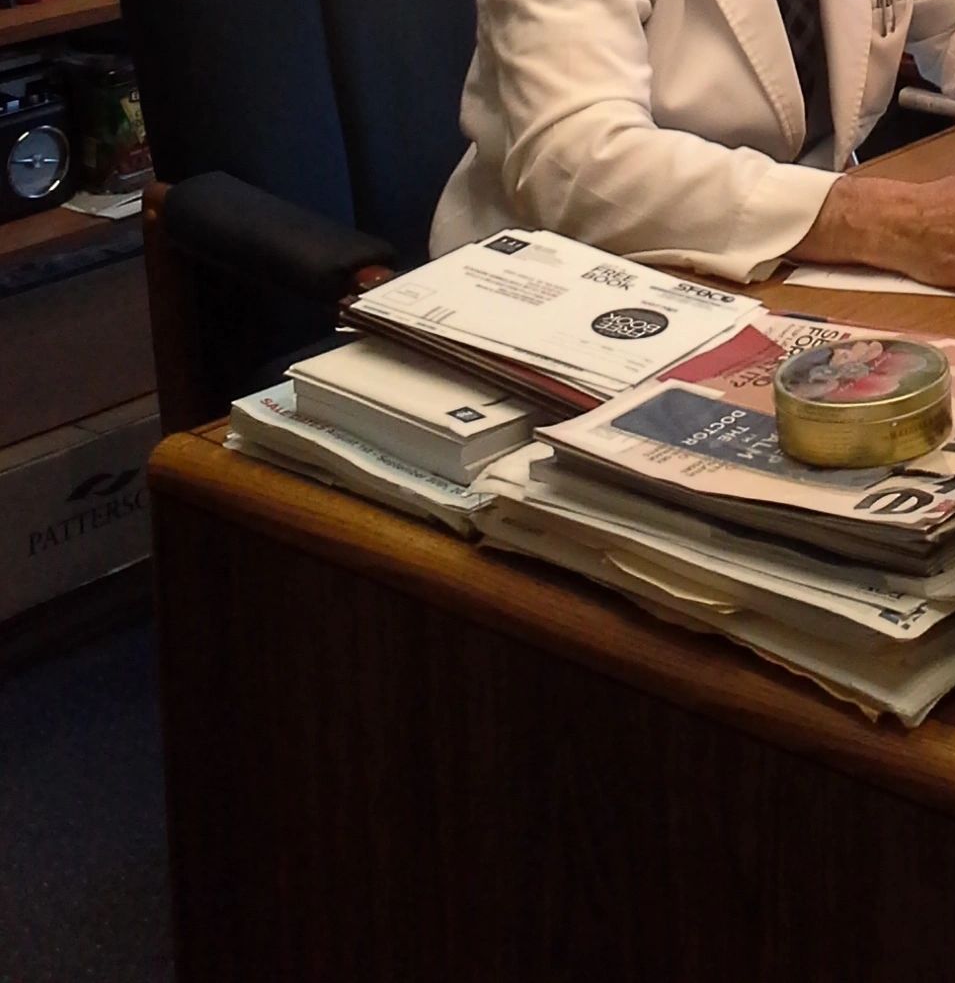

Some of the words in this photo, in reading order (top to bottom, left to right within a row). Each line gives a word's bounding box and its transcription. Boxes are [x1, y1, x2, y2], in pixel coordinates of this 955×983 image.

[581, 272, 635, 291] BOOK
[594, 320, 647, 338] FREE
[602, 313, 661, 333] BOOK
[260, 397, 292, 417] SALE
[682, 409, 748, 447] DOCTOR
[717, 425, 751, 442] THE
